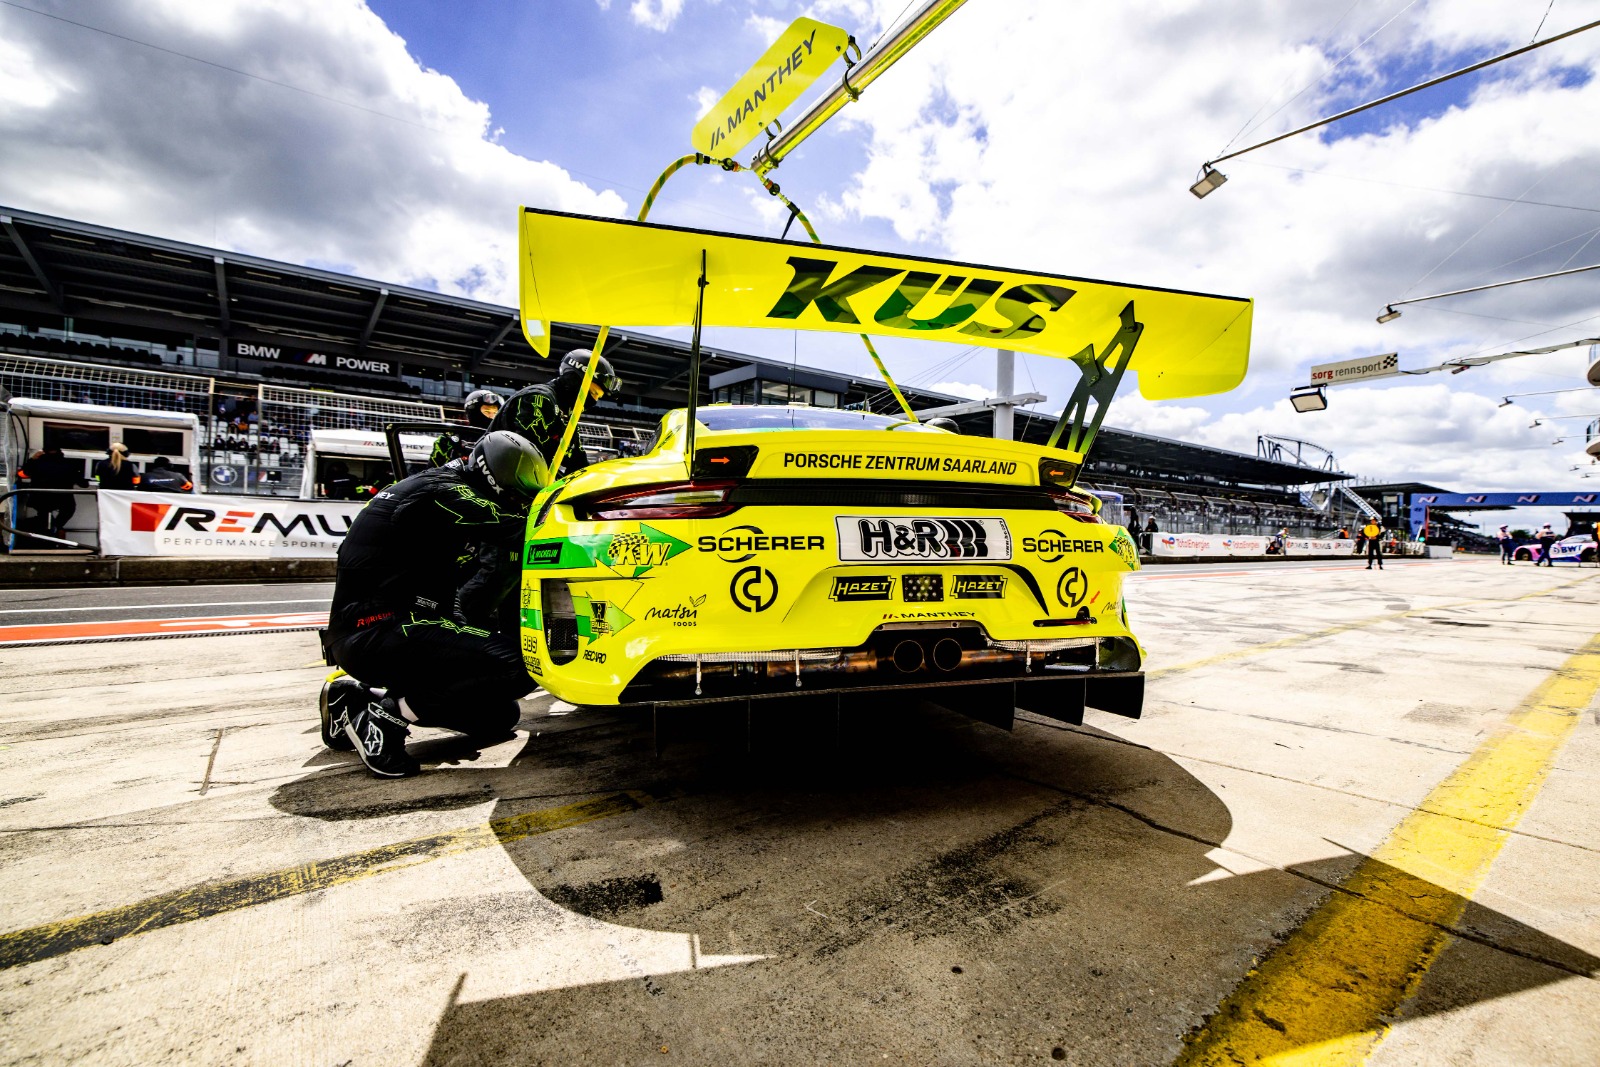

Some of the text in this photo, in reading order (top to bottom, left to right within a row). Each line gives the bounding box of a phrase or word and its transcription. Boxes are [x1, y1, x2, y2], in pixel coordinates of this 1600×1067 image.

[727, 29, 817, 134] MANTHEY
[766, 256, 1078, 340] KUS
[237, 343, 281, 359] BMW
[336, 356, 390, 373] POWER
[1311, 361, 1381, 380] sorg rennsport
[476, 454, 504, 494] uvex
[784, 453, 1017, 476] PORSCHE ZENTRUM SAARLAND
[165, 507, 354, 538] REMU
[163, 537, 276, 548] PERFORMANCE
[282, 540, 326, 548] SPORT
[698, 535, 825, 553] SCHERER
[859, 518, 949, 558] H&R
[1022, 537, 1104, 553] SCHERER
[617, 542, 672, 566] KW
[1561, 545, 1583, 553] BWT
[836, 582, 890, 594] HAZET
[957, 581, 1001, 593] HAZET
[644, 604, 697, 620] natsu
[901, 611, 976, 620] MANTHEY
[523, 635, 537, 654] BBS
[583, 650, 606, 664] RECARO
